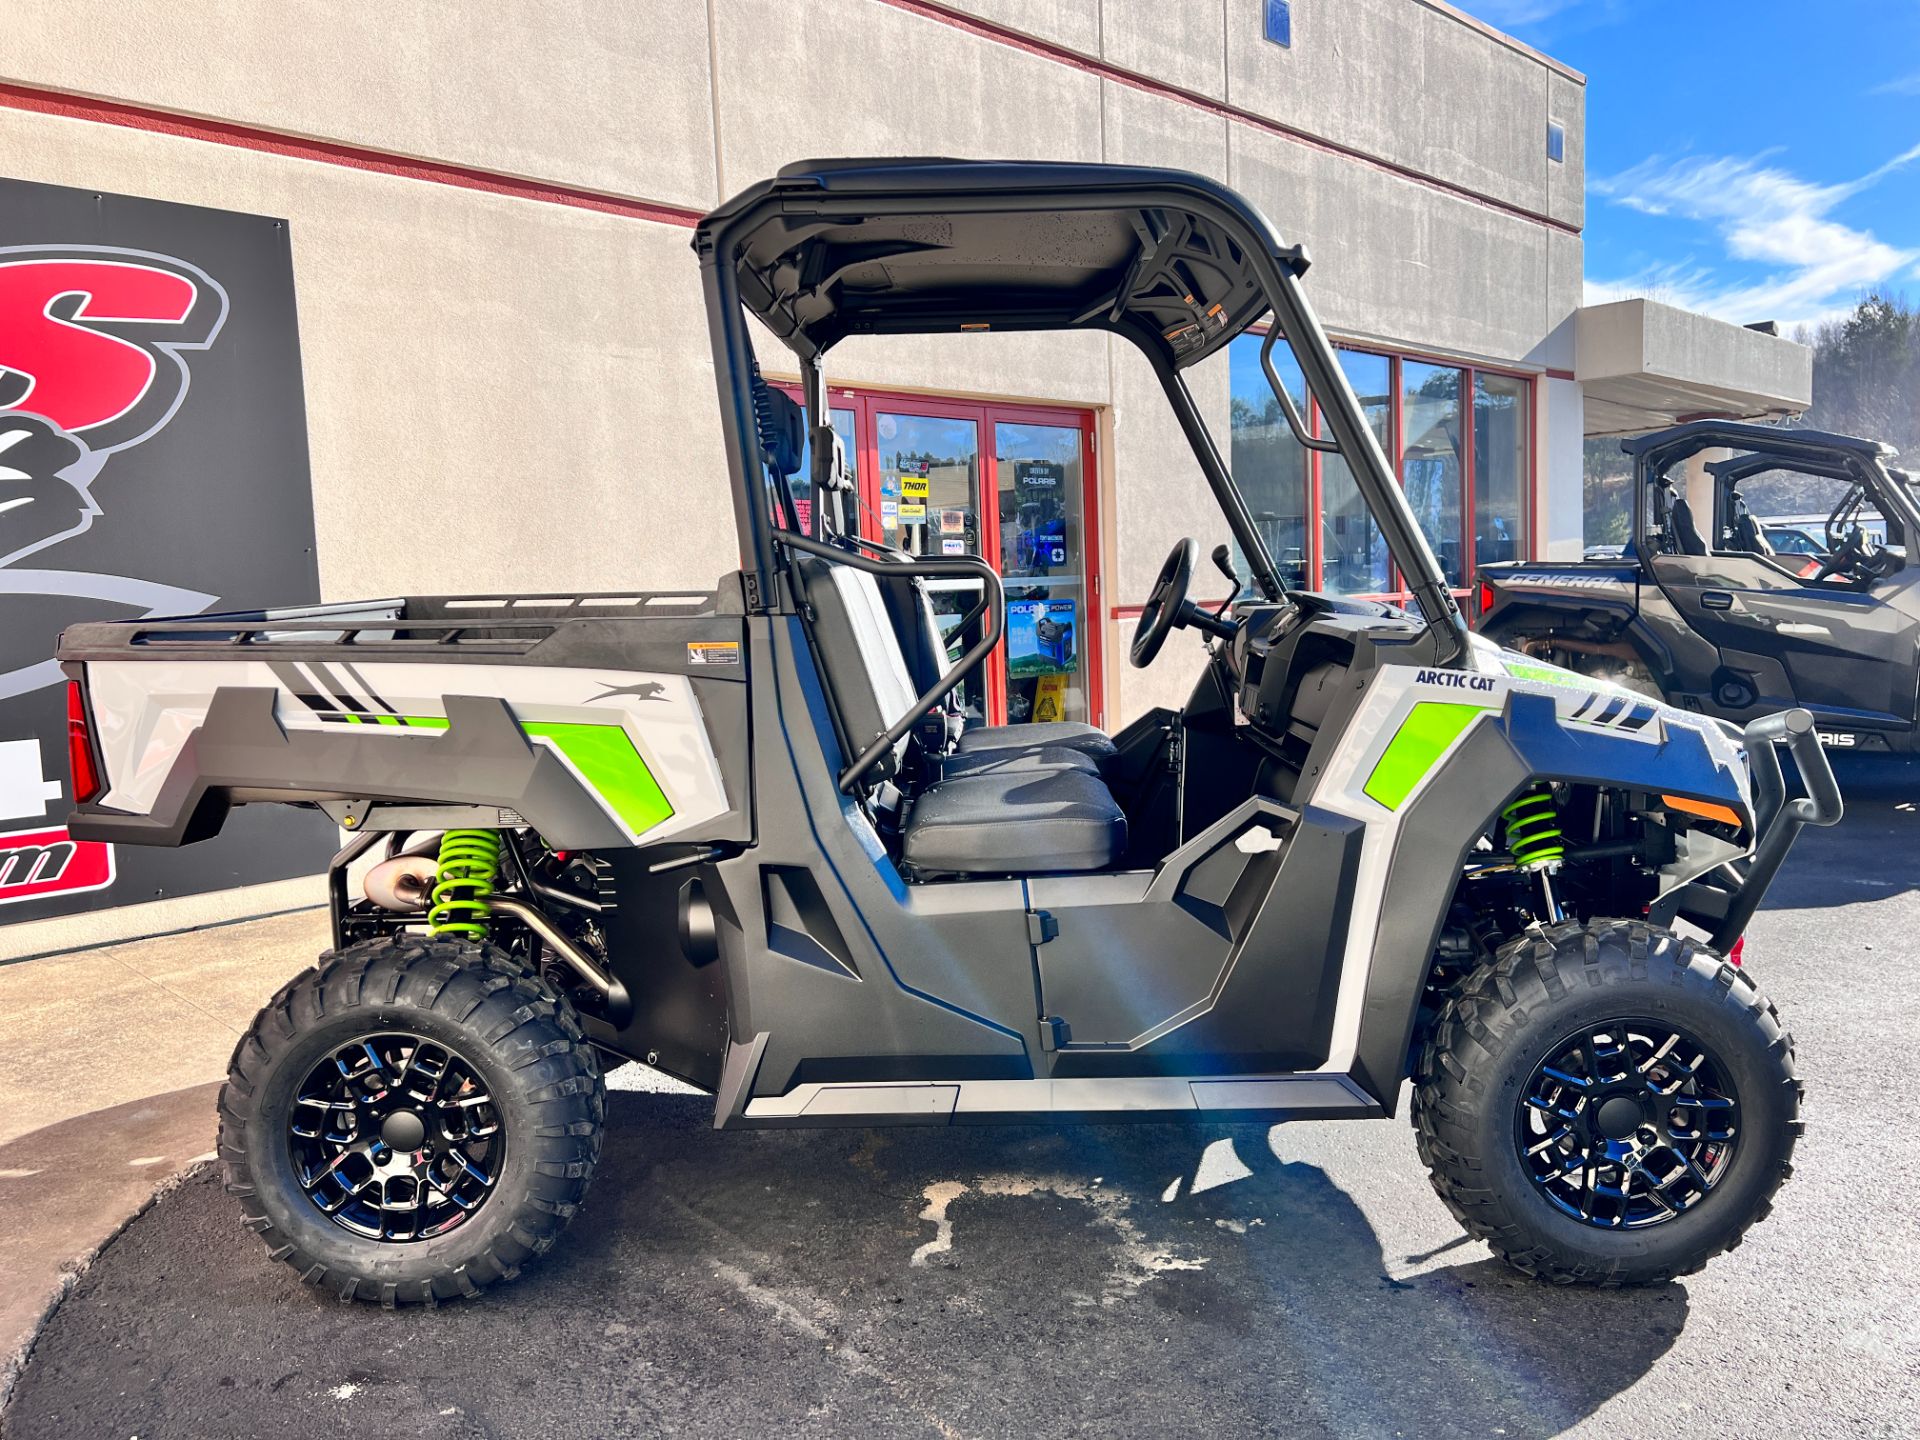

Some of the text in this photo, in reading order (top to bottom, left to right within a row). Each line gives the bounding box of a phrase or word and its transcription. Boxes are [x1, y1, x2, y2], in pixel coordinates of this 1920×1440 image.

[1023, 477, 1056, 485] POLARIS
[903, 482, 927, 491] THOR
[1505, 574, 1619, 589] GENERAL
[1051, 604, 1073, 612] POWER
[1416, 670, 1495, 691] ARCTIC CAT
